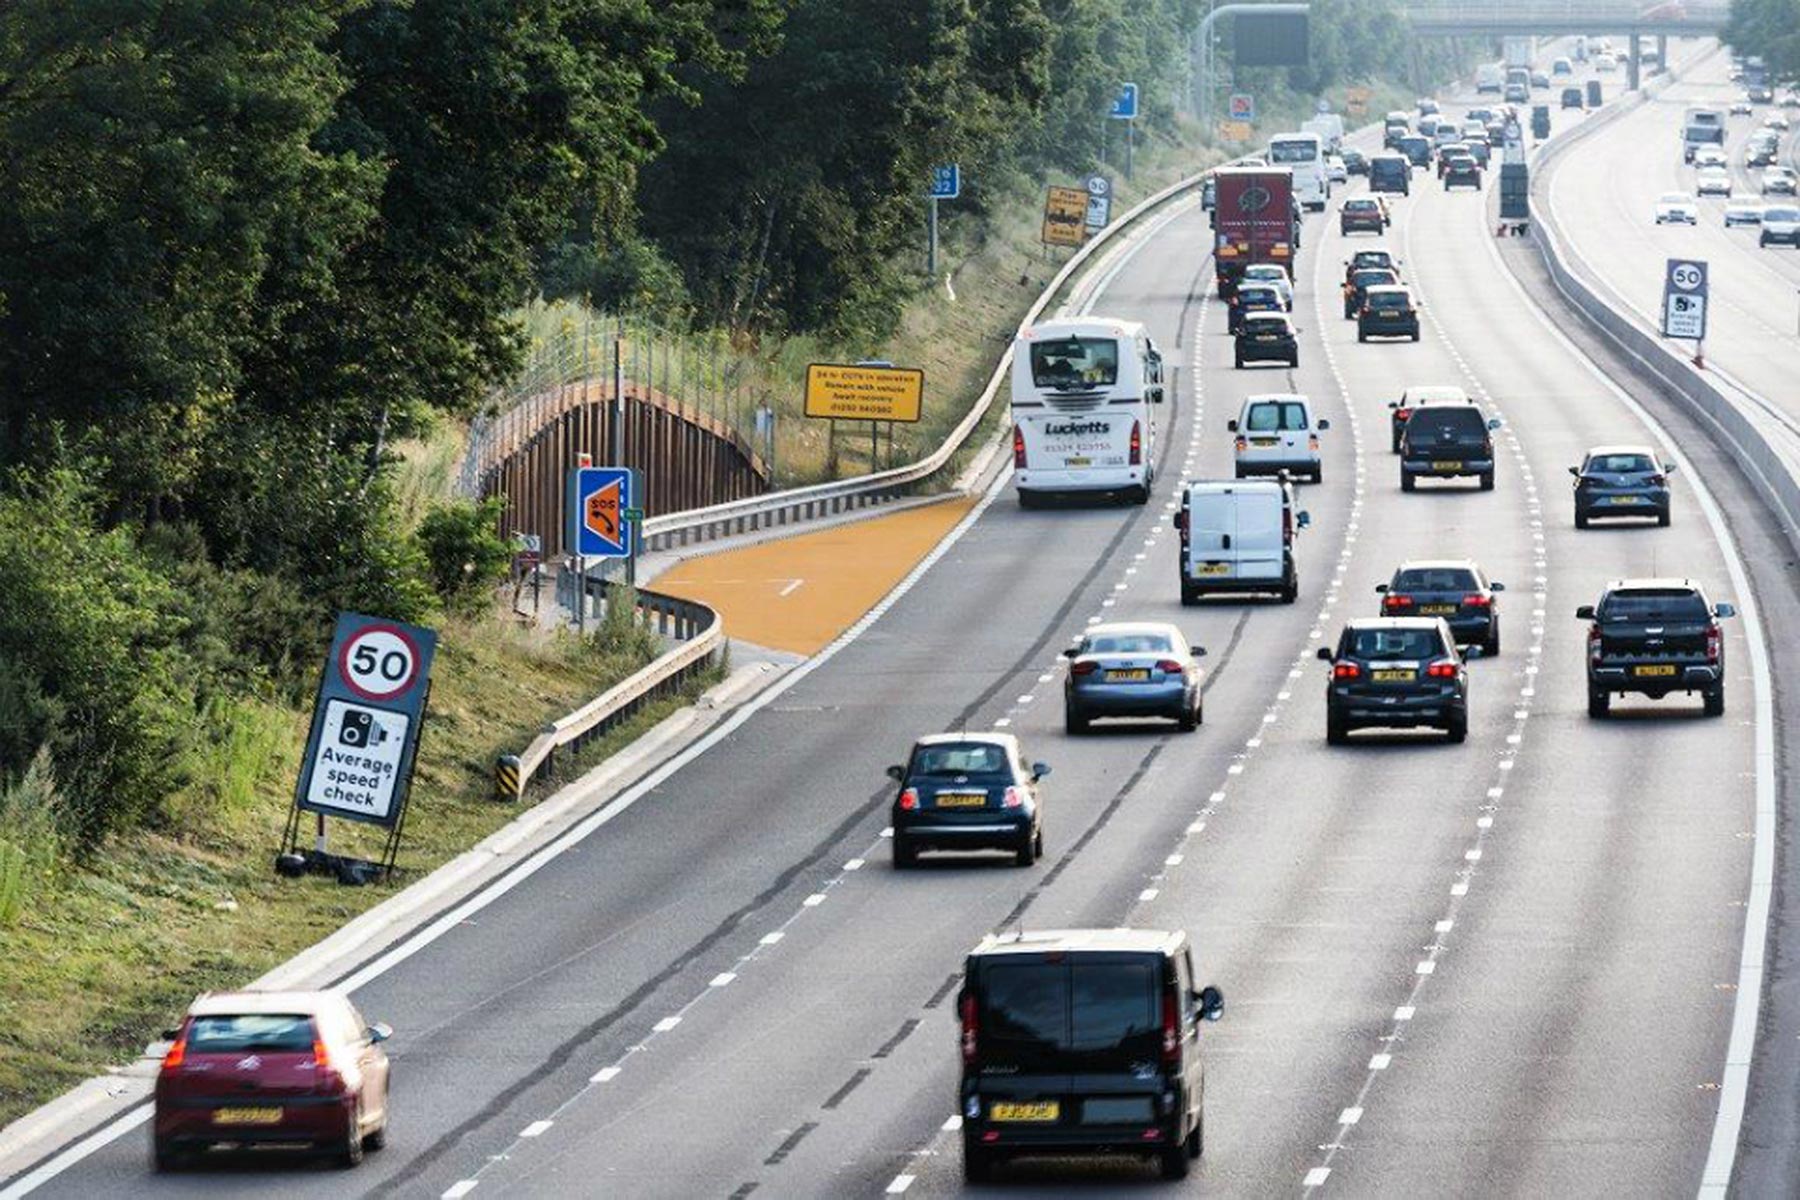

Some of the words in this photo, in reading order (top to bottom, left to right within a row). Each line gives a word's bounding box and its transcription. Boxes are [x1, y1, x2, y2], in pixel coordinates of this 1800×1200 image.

[1676, 269, 1700, 284] 50
[1045, 422, 1110, 436] Lucketts
[591, 499, 616, 509] SOS
[352, 644, 408, 682] 50
[321, 747, 393, 774] Average
[327, 767, 380, 789] speed
[323, 786, 375, 807] check
